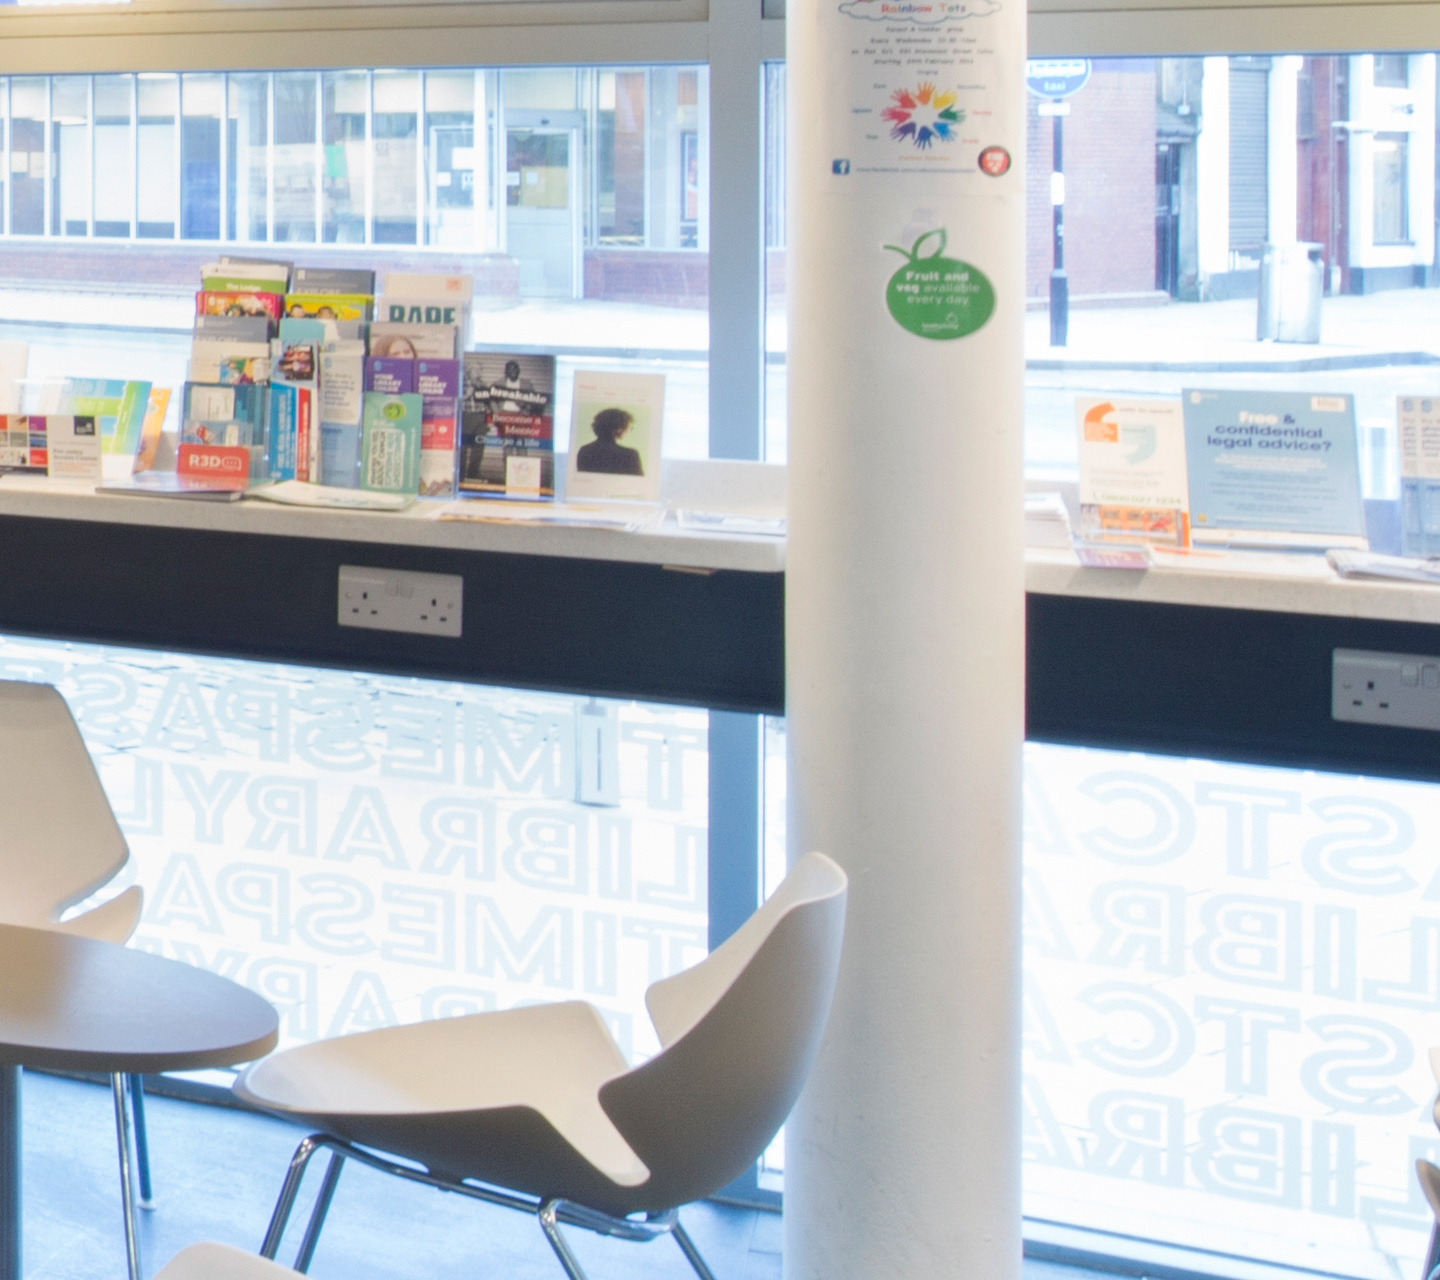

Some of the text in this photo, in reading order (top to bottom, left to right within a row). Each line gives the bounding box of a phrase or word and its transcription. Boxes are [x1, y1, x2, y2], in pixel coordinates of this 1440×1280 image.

[881, 3, 966, 14] Rainbow Tots
[906, 271, 969, 281] Fruit and
[896, 283, 980, 294] veg available
[906, 295, 970, 306] every day
[492, 414, 531, 424] Become
[1239, 411, 1295, 425] Free &
[505, 425, 540, 434] Mentor
[1215, 425, 1323, 439] confidential
[475, 436, 514, 445] Change
[525, 438, 540, 446] life
[1207, 437, 1332, 451] legal advice?
[188, 454, 221, 468] R3D
